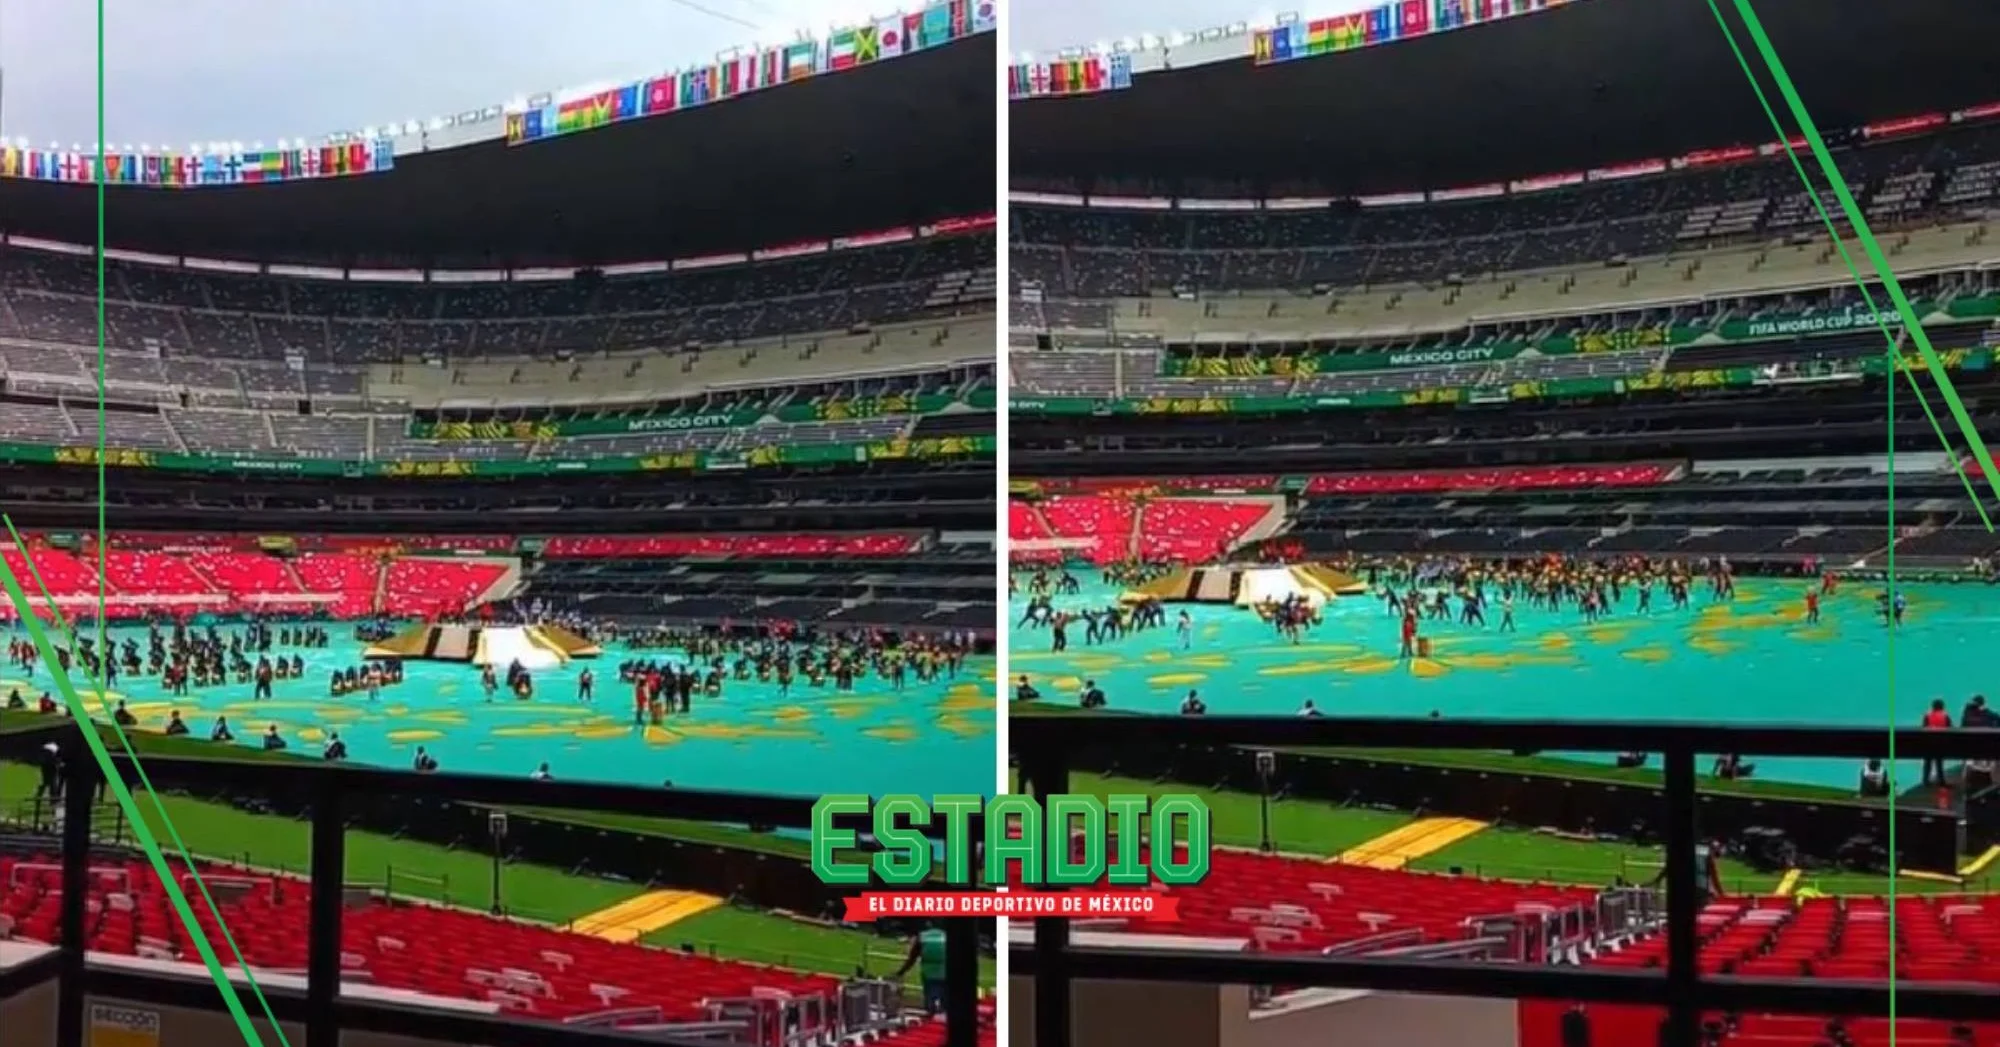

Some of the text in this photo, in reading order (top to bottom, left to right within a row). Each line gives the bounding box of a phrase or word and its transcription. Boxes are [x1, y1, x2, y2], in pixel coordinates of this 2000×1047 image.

[1750, 322, 1776, 335] FIFA
[1778, 317, 1825, 332] WORLD
[1389, 347, 1494, 365] MEXICO CITY
[627, 414, 733, 431] MEXICO CITY
